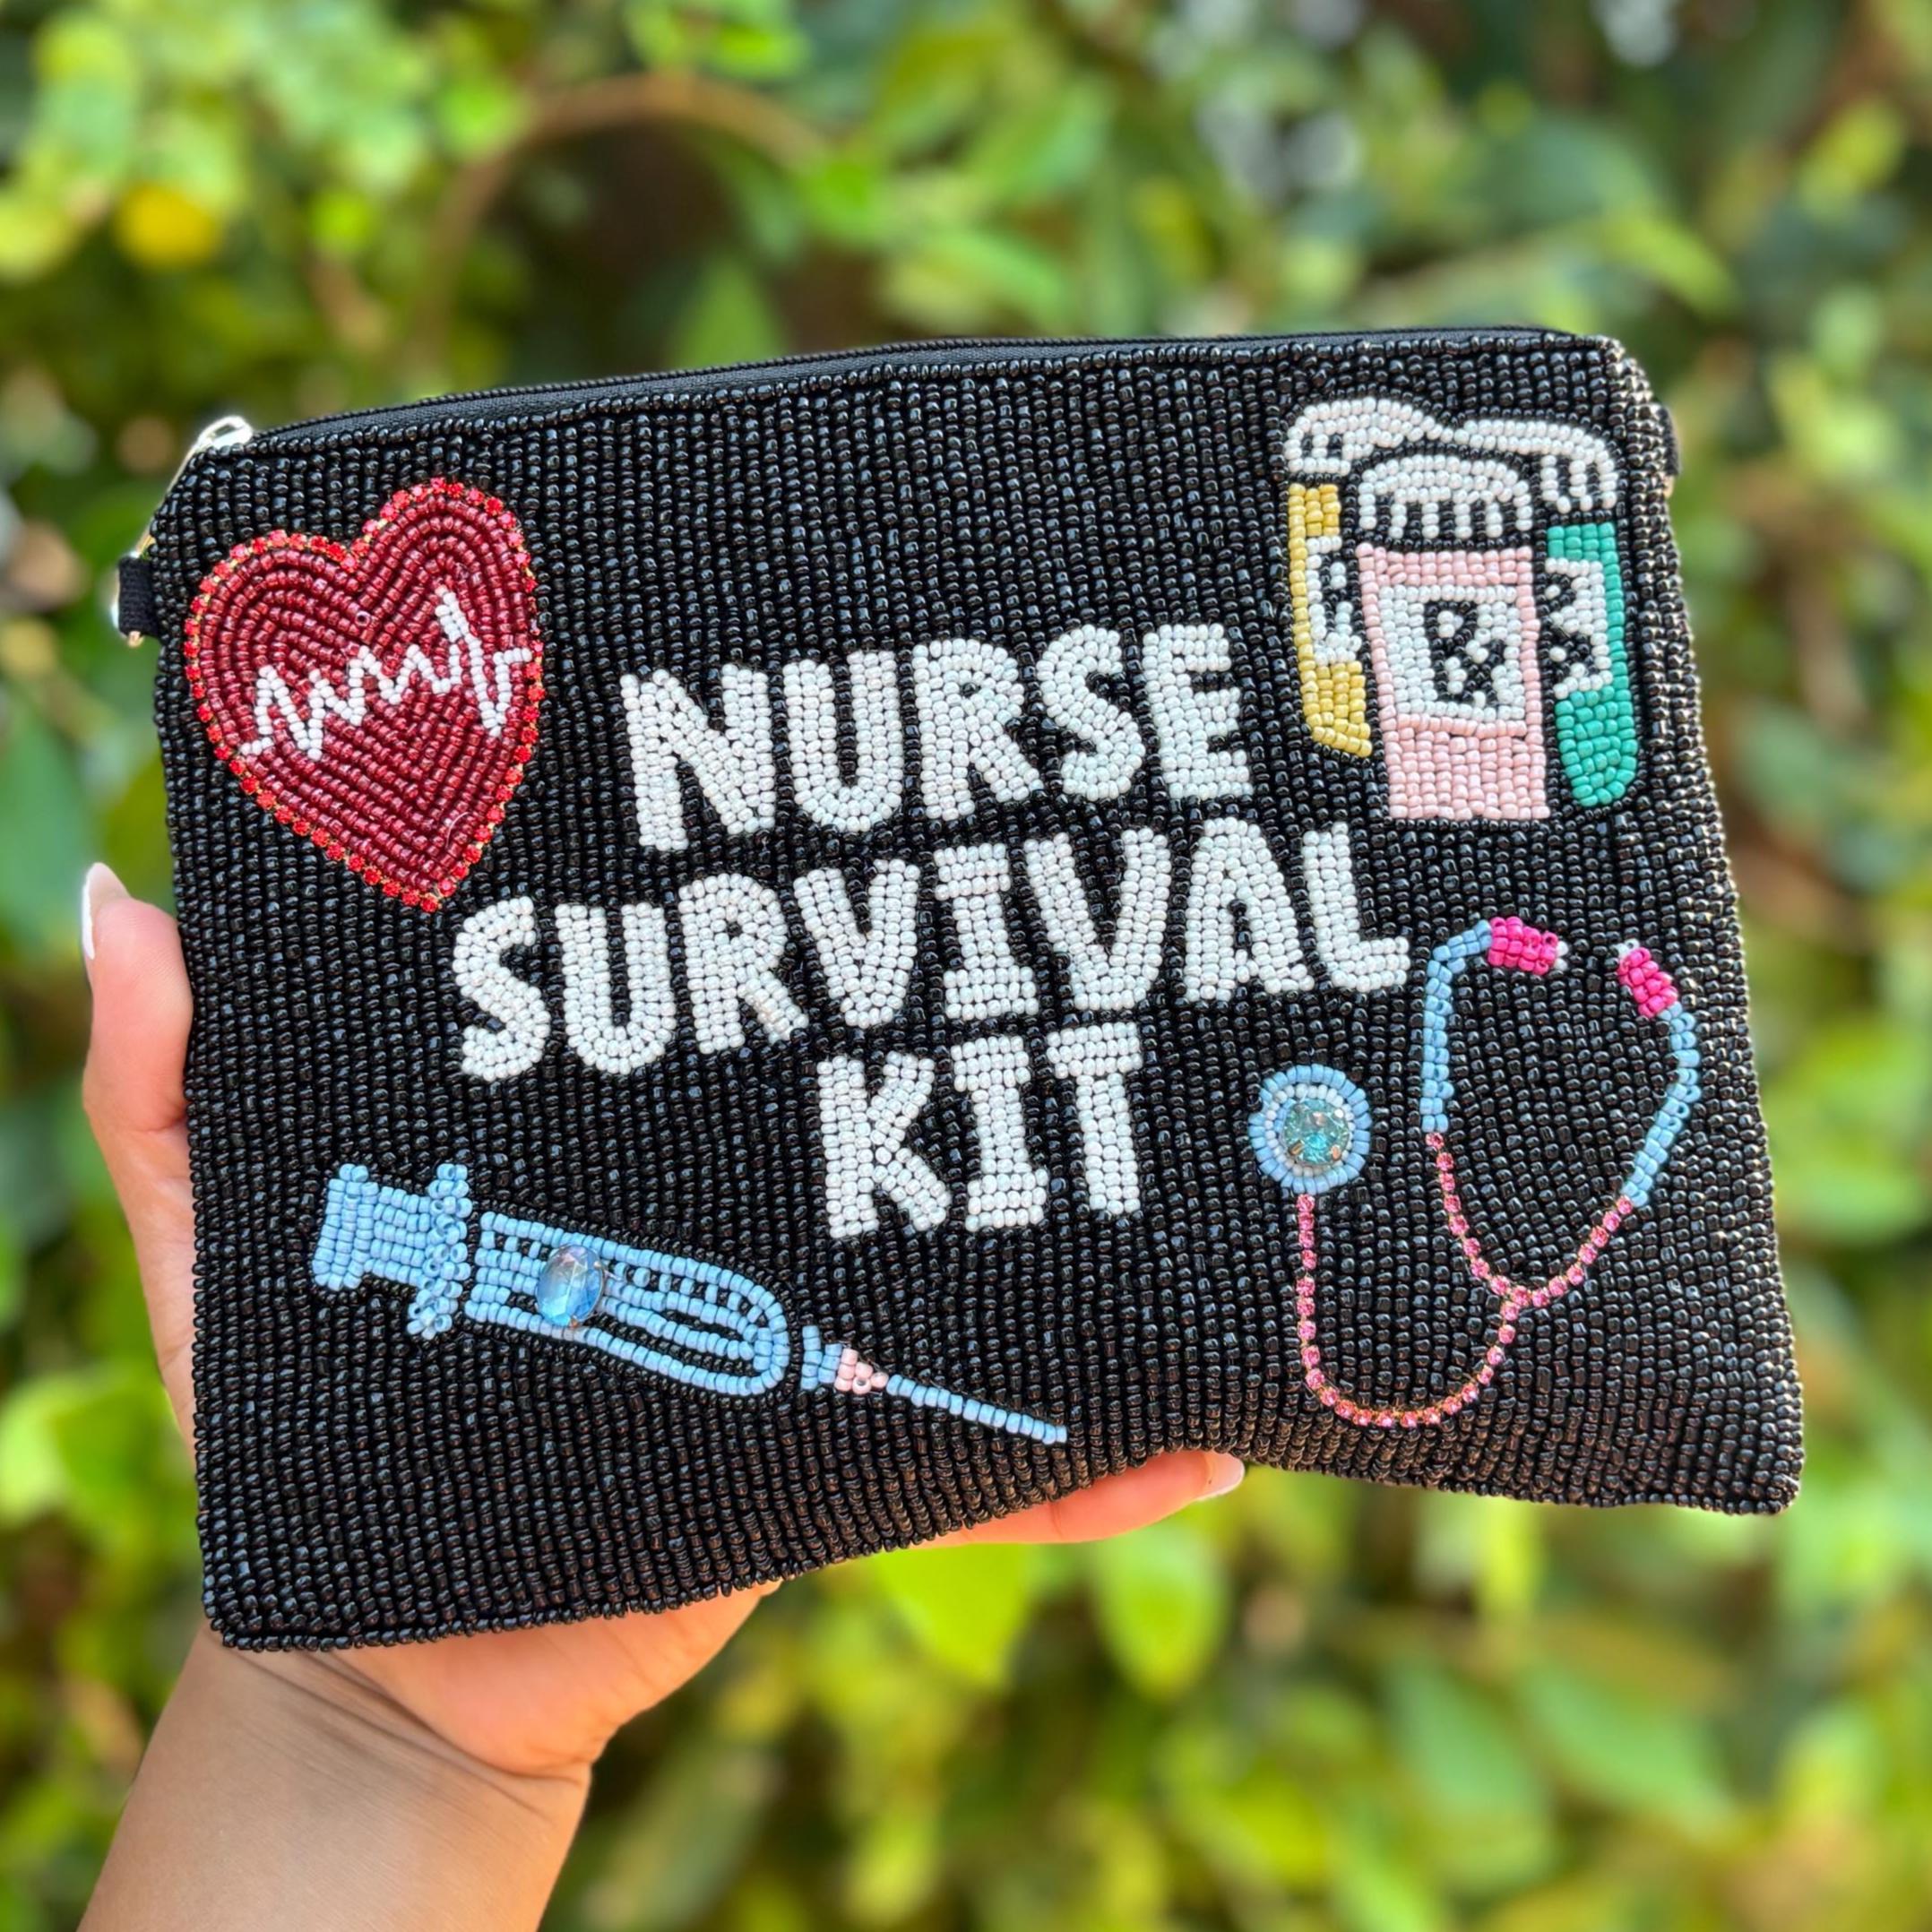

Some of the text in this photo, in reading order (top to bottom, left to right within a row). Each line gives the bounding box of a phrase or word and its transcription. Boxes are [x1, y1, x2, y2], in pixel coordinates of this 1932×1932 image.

[621, 623, 1255, 851] NURSE
[452, 817, 1410, 1082] SURVIVAL
[816, 1021, 1144, 1240] KIT
